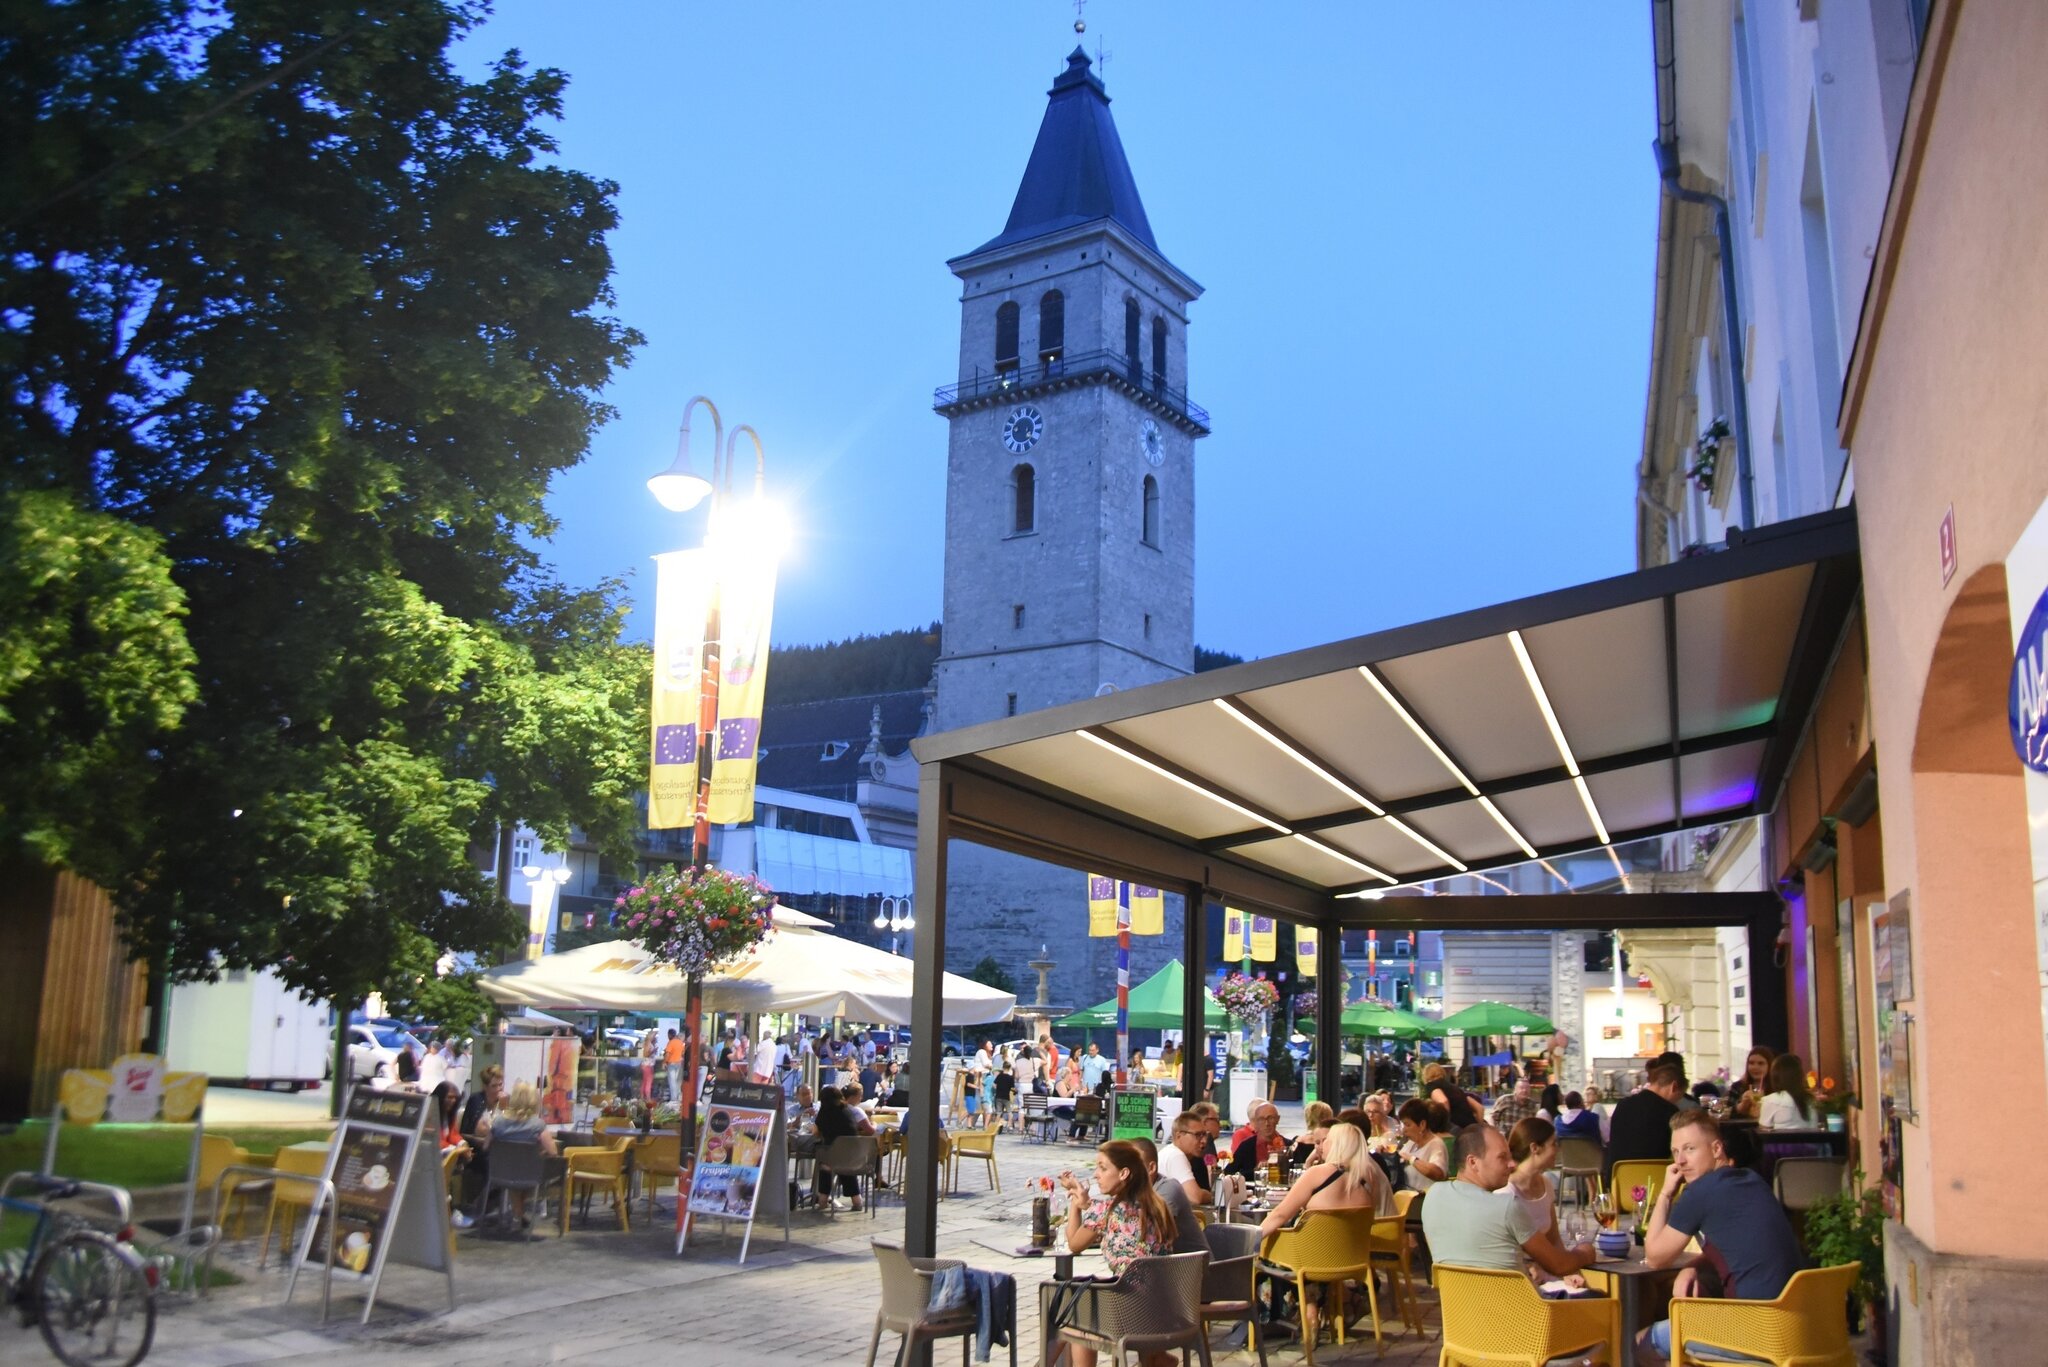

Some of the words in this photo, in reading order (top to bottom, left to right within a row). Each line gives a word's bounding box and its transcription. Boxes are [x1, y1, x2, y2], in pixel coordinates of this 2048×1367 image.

[1117, 1096, 1129, 1105] OLD
[1130, 1097, 1152, 1105] SCHOOL
[730, 1115, 769, 1126] Smoothie
[700, 1165, 731, 1176] Frappé
